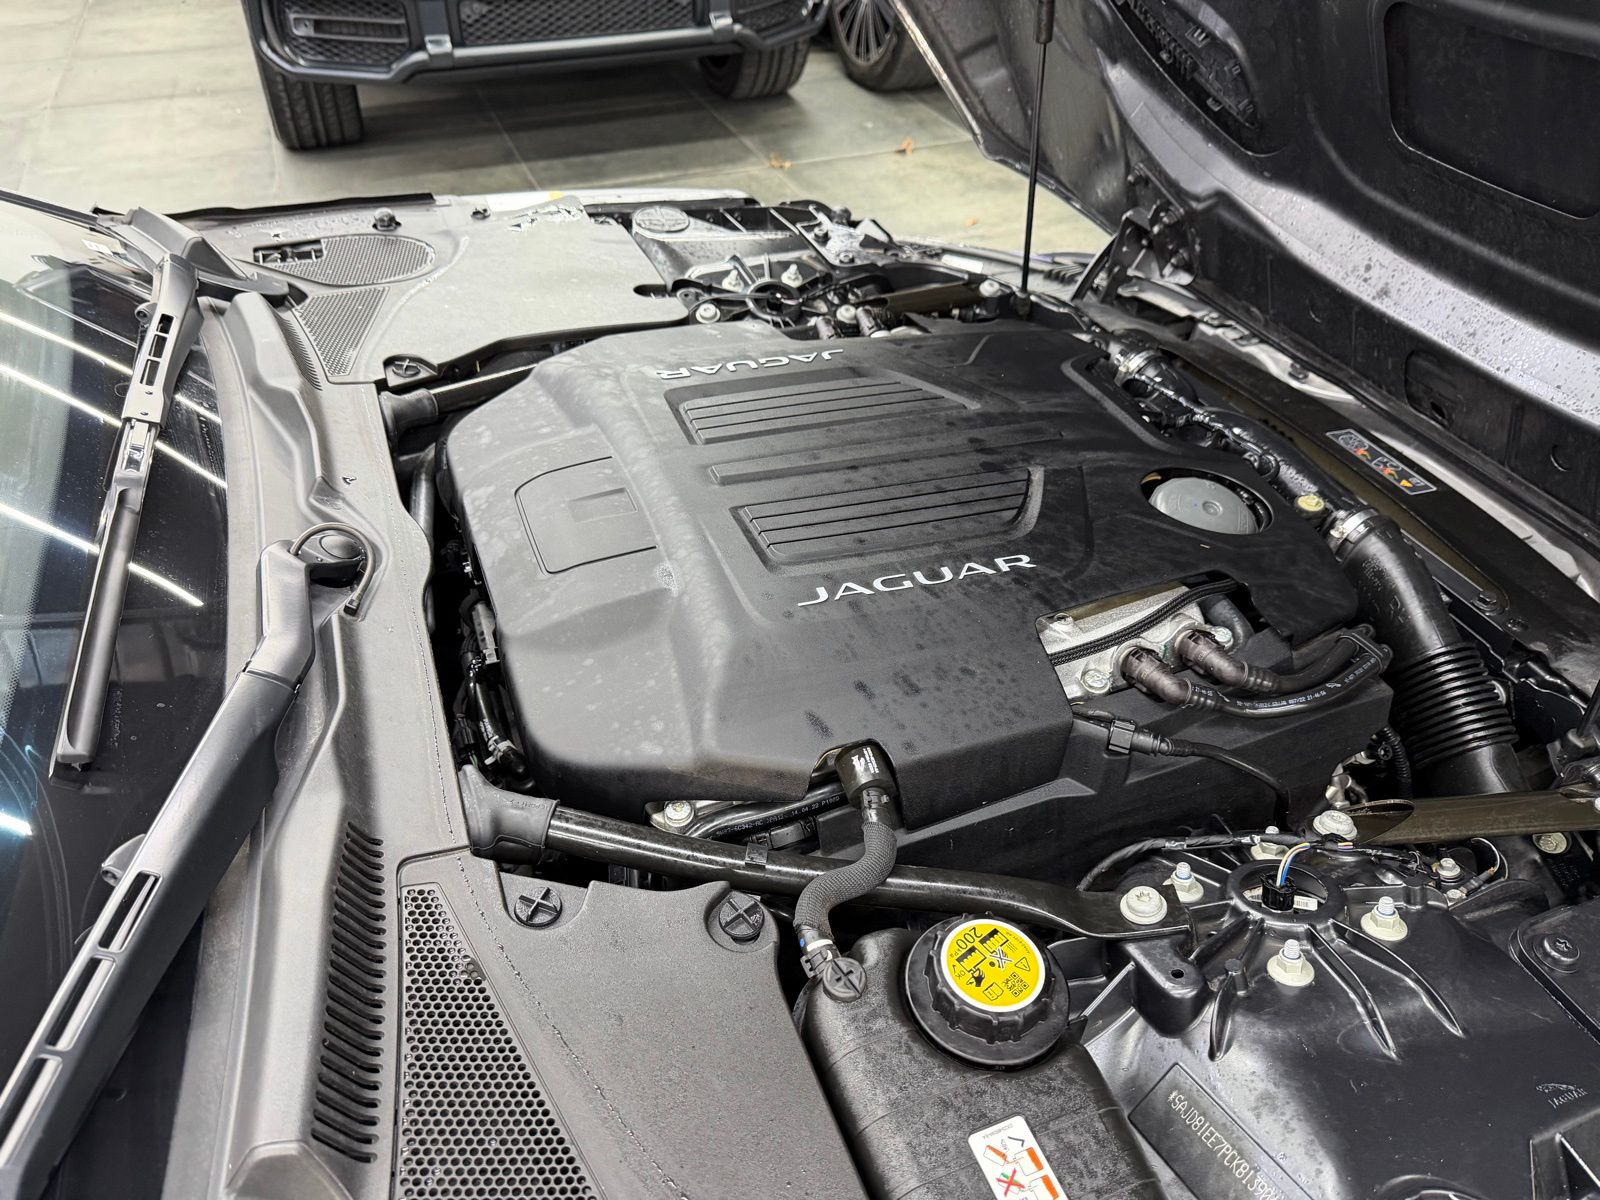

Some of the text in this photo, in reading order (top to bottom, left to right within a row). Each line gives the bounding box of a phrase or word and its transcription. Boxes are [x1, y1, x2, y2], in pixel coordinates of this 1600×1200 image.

[656, 349, 844, 380] JAGUAR
[797, 554, 1037, 607] JAGUAR
[956, 926, 984, 950] 200
